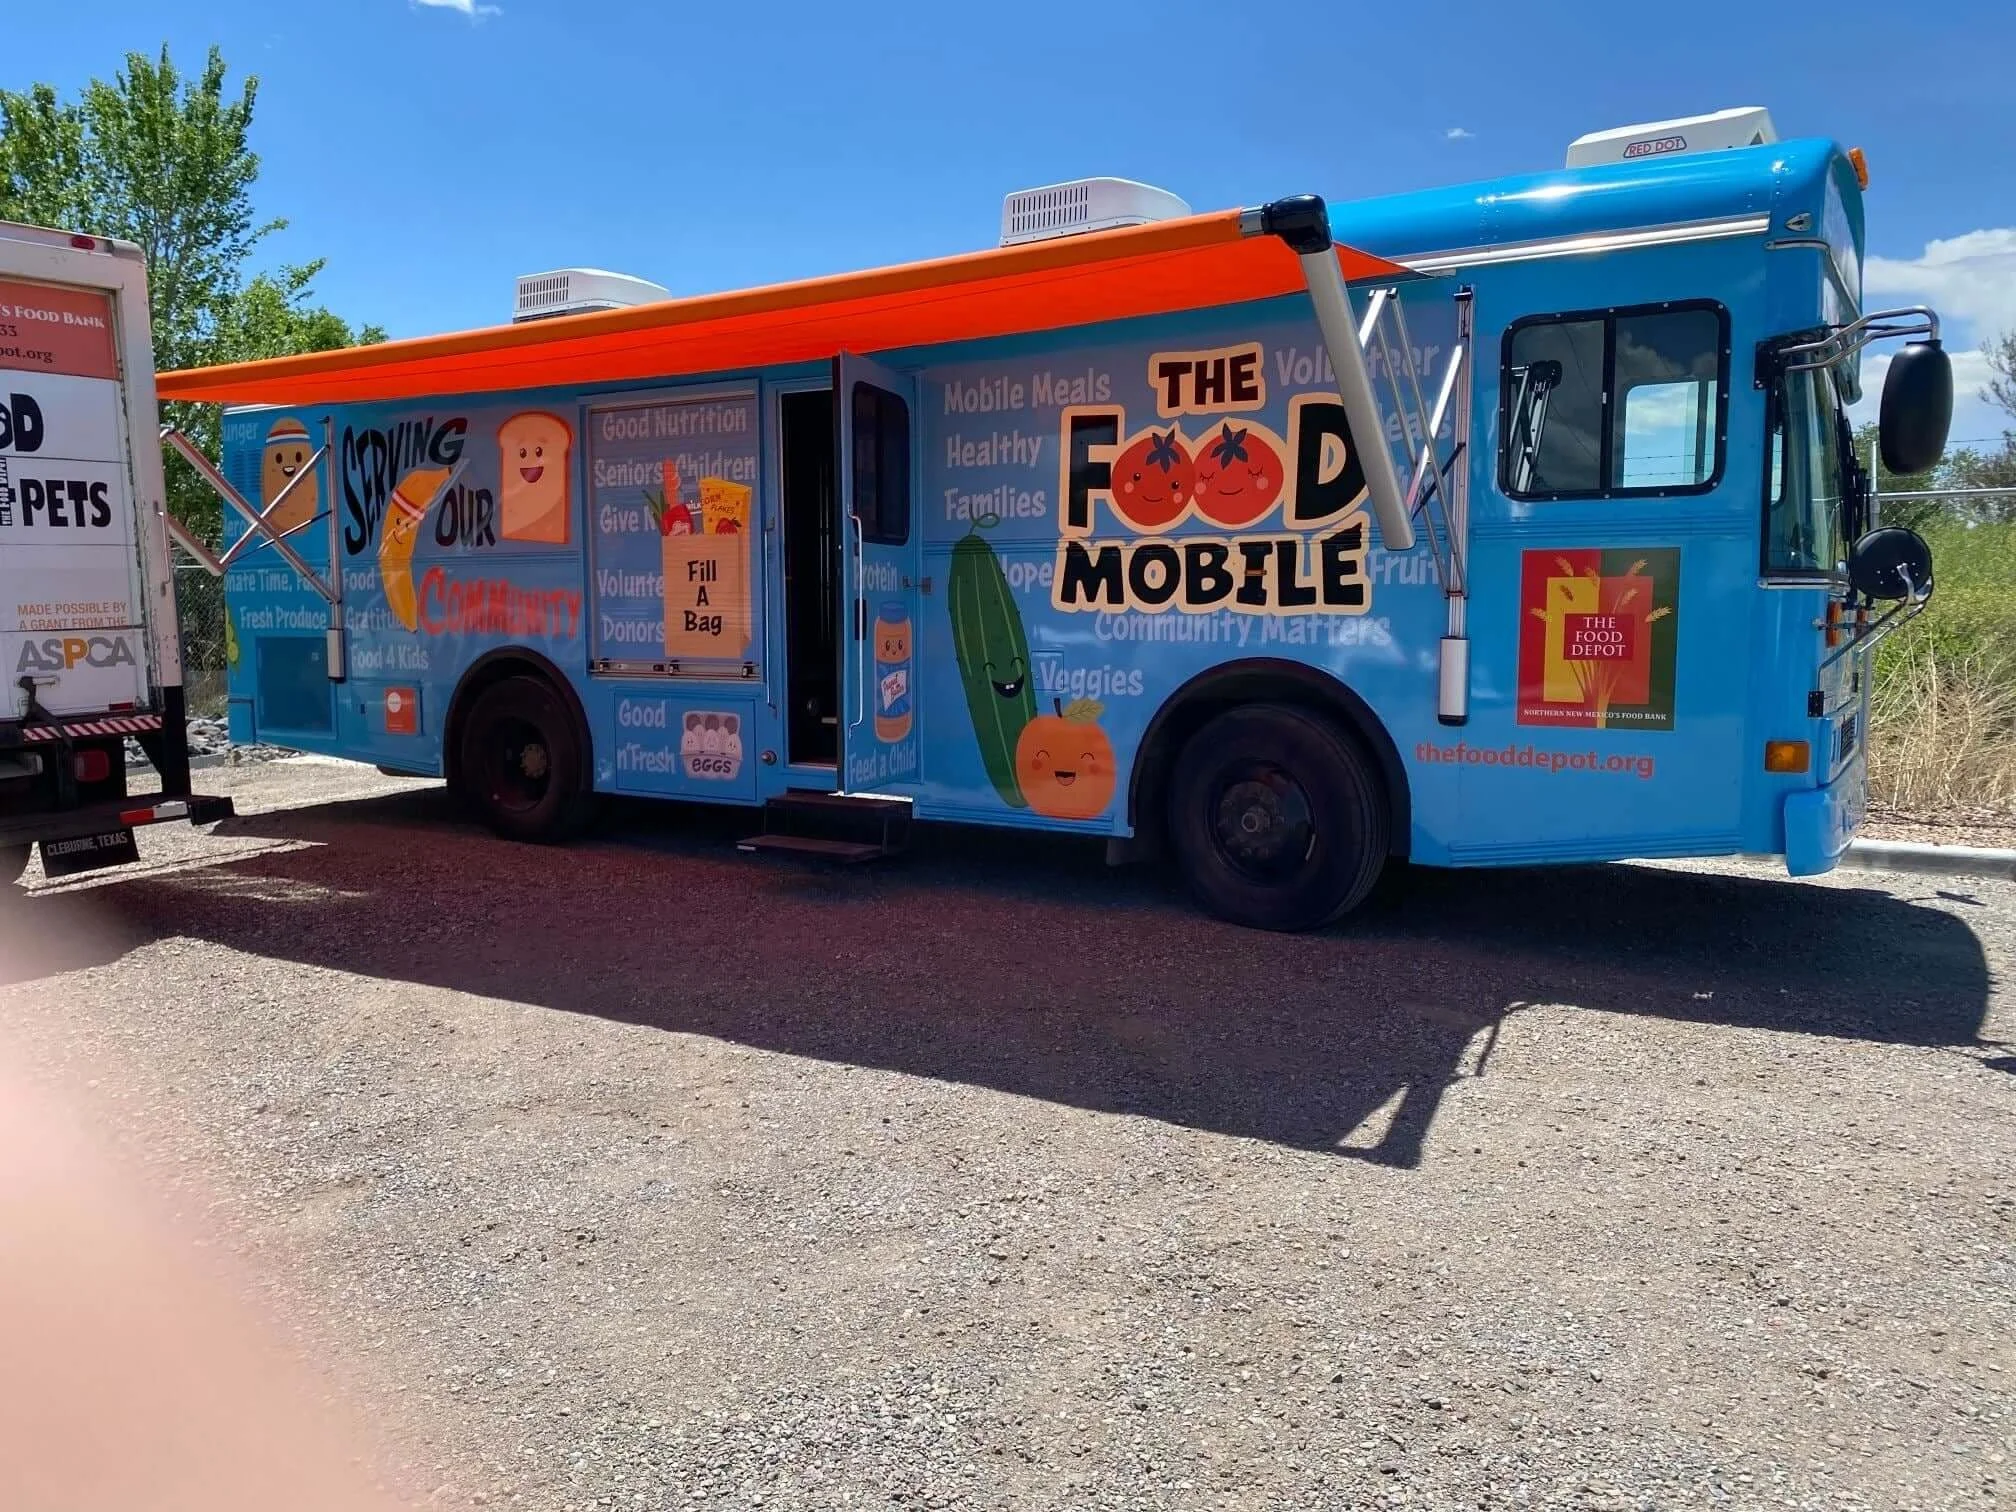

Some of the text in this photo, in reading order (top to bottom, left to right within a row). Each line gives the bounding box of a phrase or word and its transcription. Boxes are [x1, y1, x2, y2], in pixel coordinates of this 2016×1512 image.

[1629, 139, 1680, 155] RED DOT
[14, 305, 60, 323] FOOD
[63, 311, 105, 328] BANK
[943, 367, 1112, 416] Mobile Meals
[1158, 352, 1258, 408] THE
[602, 406, 747, 441] Good Nutrition
[946, 429, 1043, 469] Healthy
[676, 450, 756, 481] Children
[1066, 401, 1369, 529] FOOD
[343, 416, 469, 556] SERVING
[20, 478, 111, 528] PETS
[435, 483, 497, 547] OUR
[943, 484, 1047, 521] Families
[600, 503, 639, 533] Give
[687, 559, 717, 582] Fill
[1060, 522, 1364, 606] MOBILE
[343, 568, 376, 591] Food
[596, 568, 665, 598] Volunte
[17, 601, 127, 616] MADE POSSIBLE BY
[419, 566, 582, 639] COMMUNITY
[696, 585, 709, 607] A
[31, 618, 67, 631] GRANT
[71, 617, 104, 630] FROM
[105, 616, 128, 628] THE
[240, 605, 328, 630] Fresh Produce
[602, 614, 665, 642] Donors
[683, 609, 722, 636] Bag
[1094, 611, 1393, 648] Community Matters
[1582, 616, 1617, 629] THE
[1571, 644, 1627, 657] DEPOT
[1575, 631, 1624, 643] FOOD
[16, 636, 137, 673] ASPCA
[351, 643, 429, 671] Food 4 Kids
[1039, 660, 1145, 700] Veggies
[618, 699, 666, 728] Good
[1523, 708, 1667, 721] NORTHERN NEW MEXICO'S FOOD BANK
[849, 744, 917, 786] Feed a Child
[1415, 742, 1655, 779] thefooddepot.org
[97, 832, 128, 848] TEXAS
